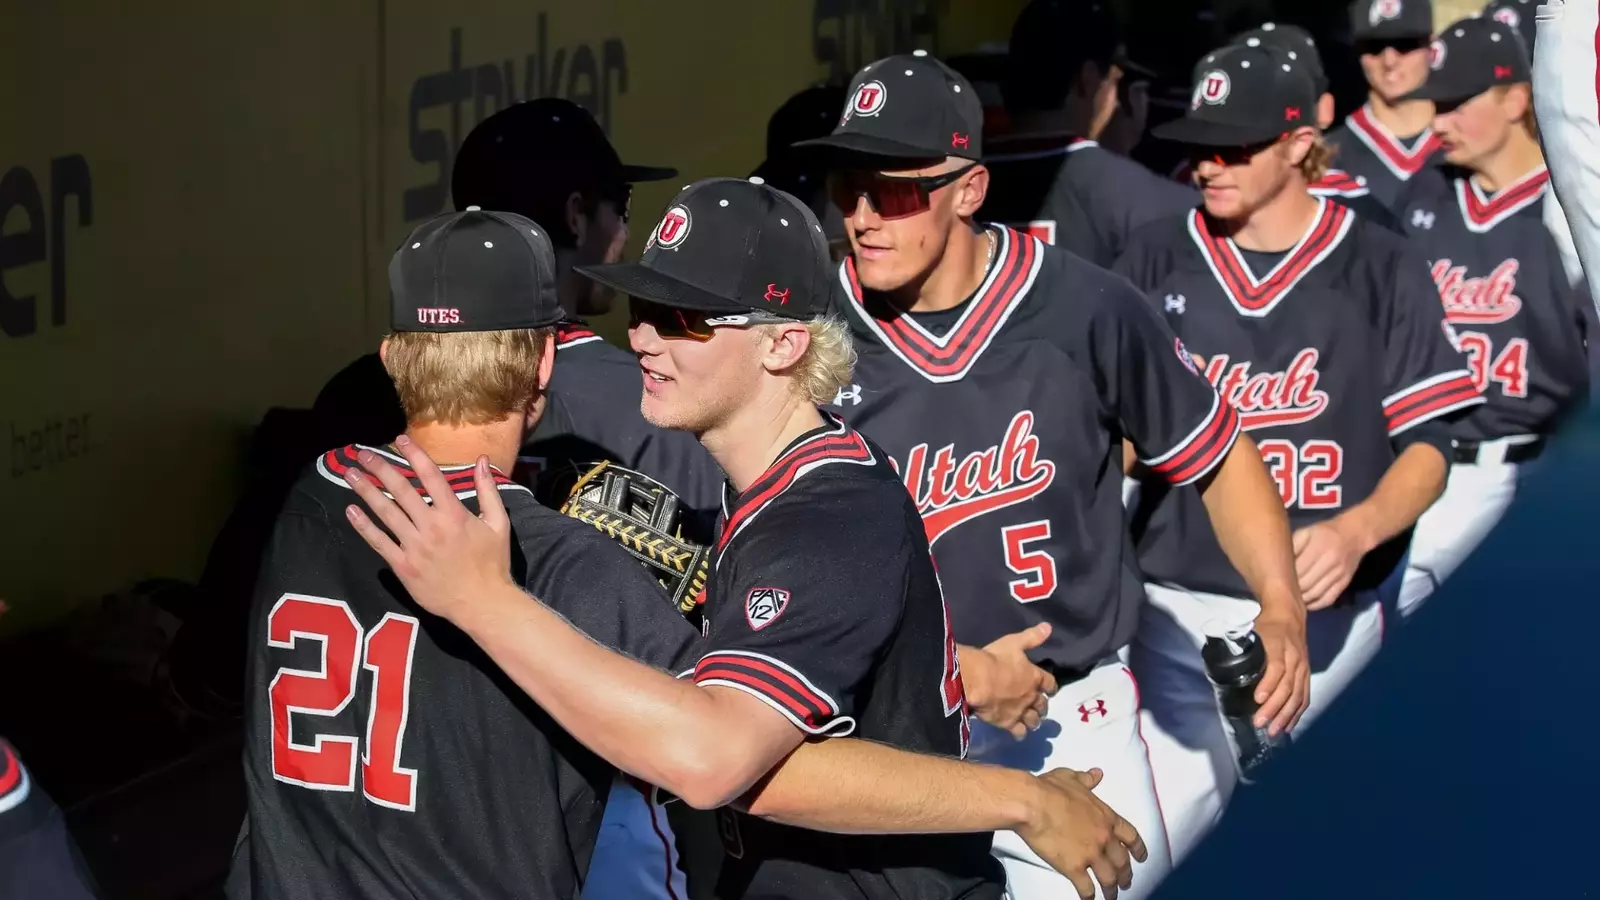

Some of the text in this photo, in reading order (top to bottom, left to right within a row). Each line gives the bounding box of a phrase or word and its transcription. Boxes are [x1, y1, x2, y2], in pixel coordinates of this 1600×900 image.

[858, 88, 880, 110] U
[1207, 78, 1223, 97] U
[660, 212, 686, 242] U
[417, 307, 461, 324] UTES
[1431, 258, 1522, 323] tah
[1205, 347, 1329, 427] tah
[1459, 331, 1529, 398] 34
[1257, 439, 1343, 509] 32
[1001, 519, 1058, 604] 5
[751, 605, 772, 620] 12
[268, 593, 419, 812] 21
